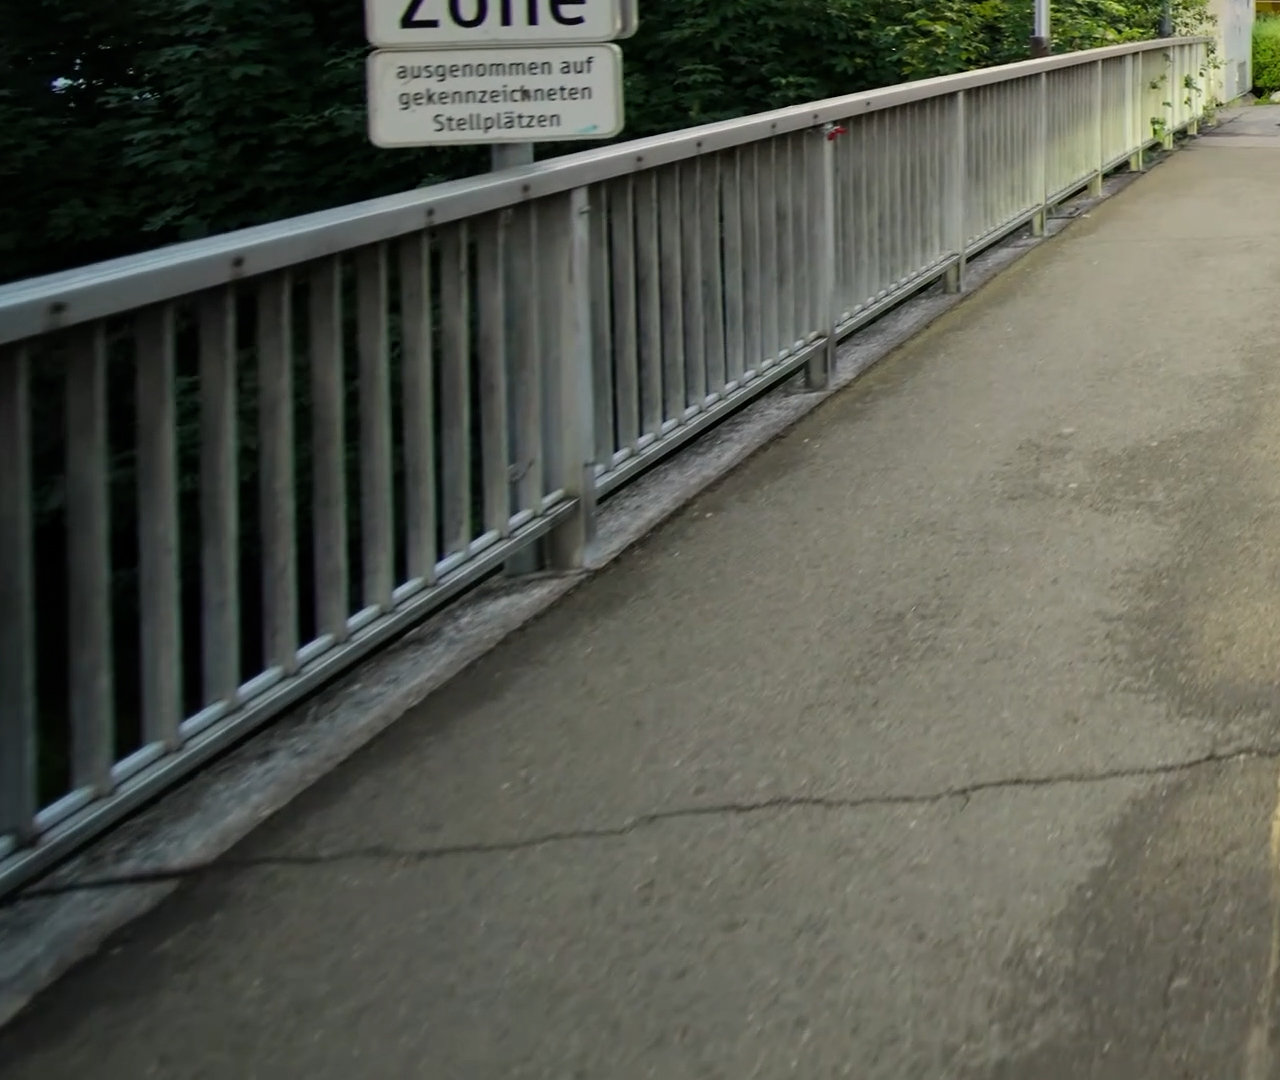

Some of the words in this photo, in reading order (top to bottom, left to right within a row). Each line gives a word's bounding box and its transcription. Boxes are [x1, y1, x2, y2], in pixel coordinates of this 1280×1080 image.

[396, 58, 552, 82] ausgenommen
[560, 56, 595, 74] auf
[398, 84, 593, 111] gekennzeichneten
[433, 111, 561, 134] Stellplätzen
